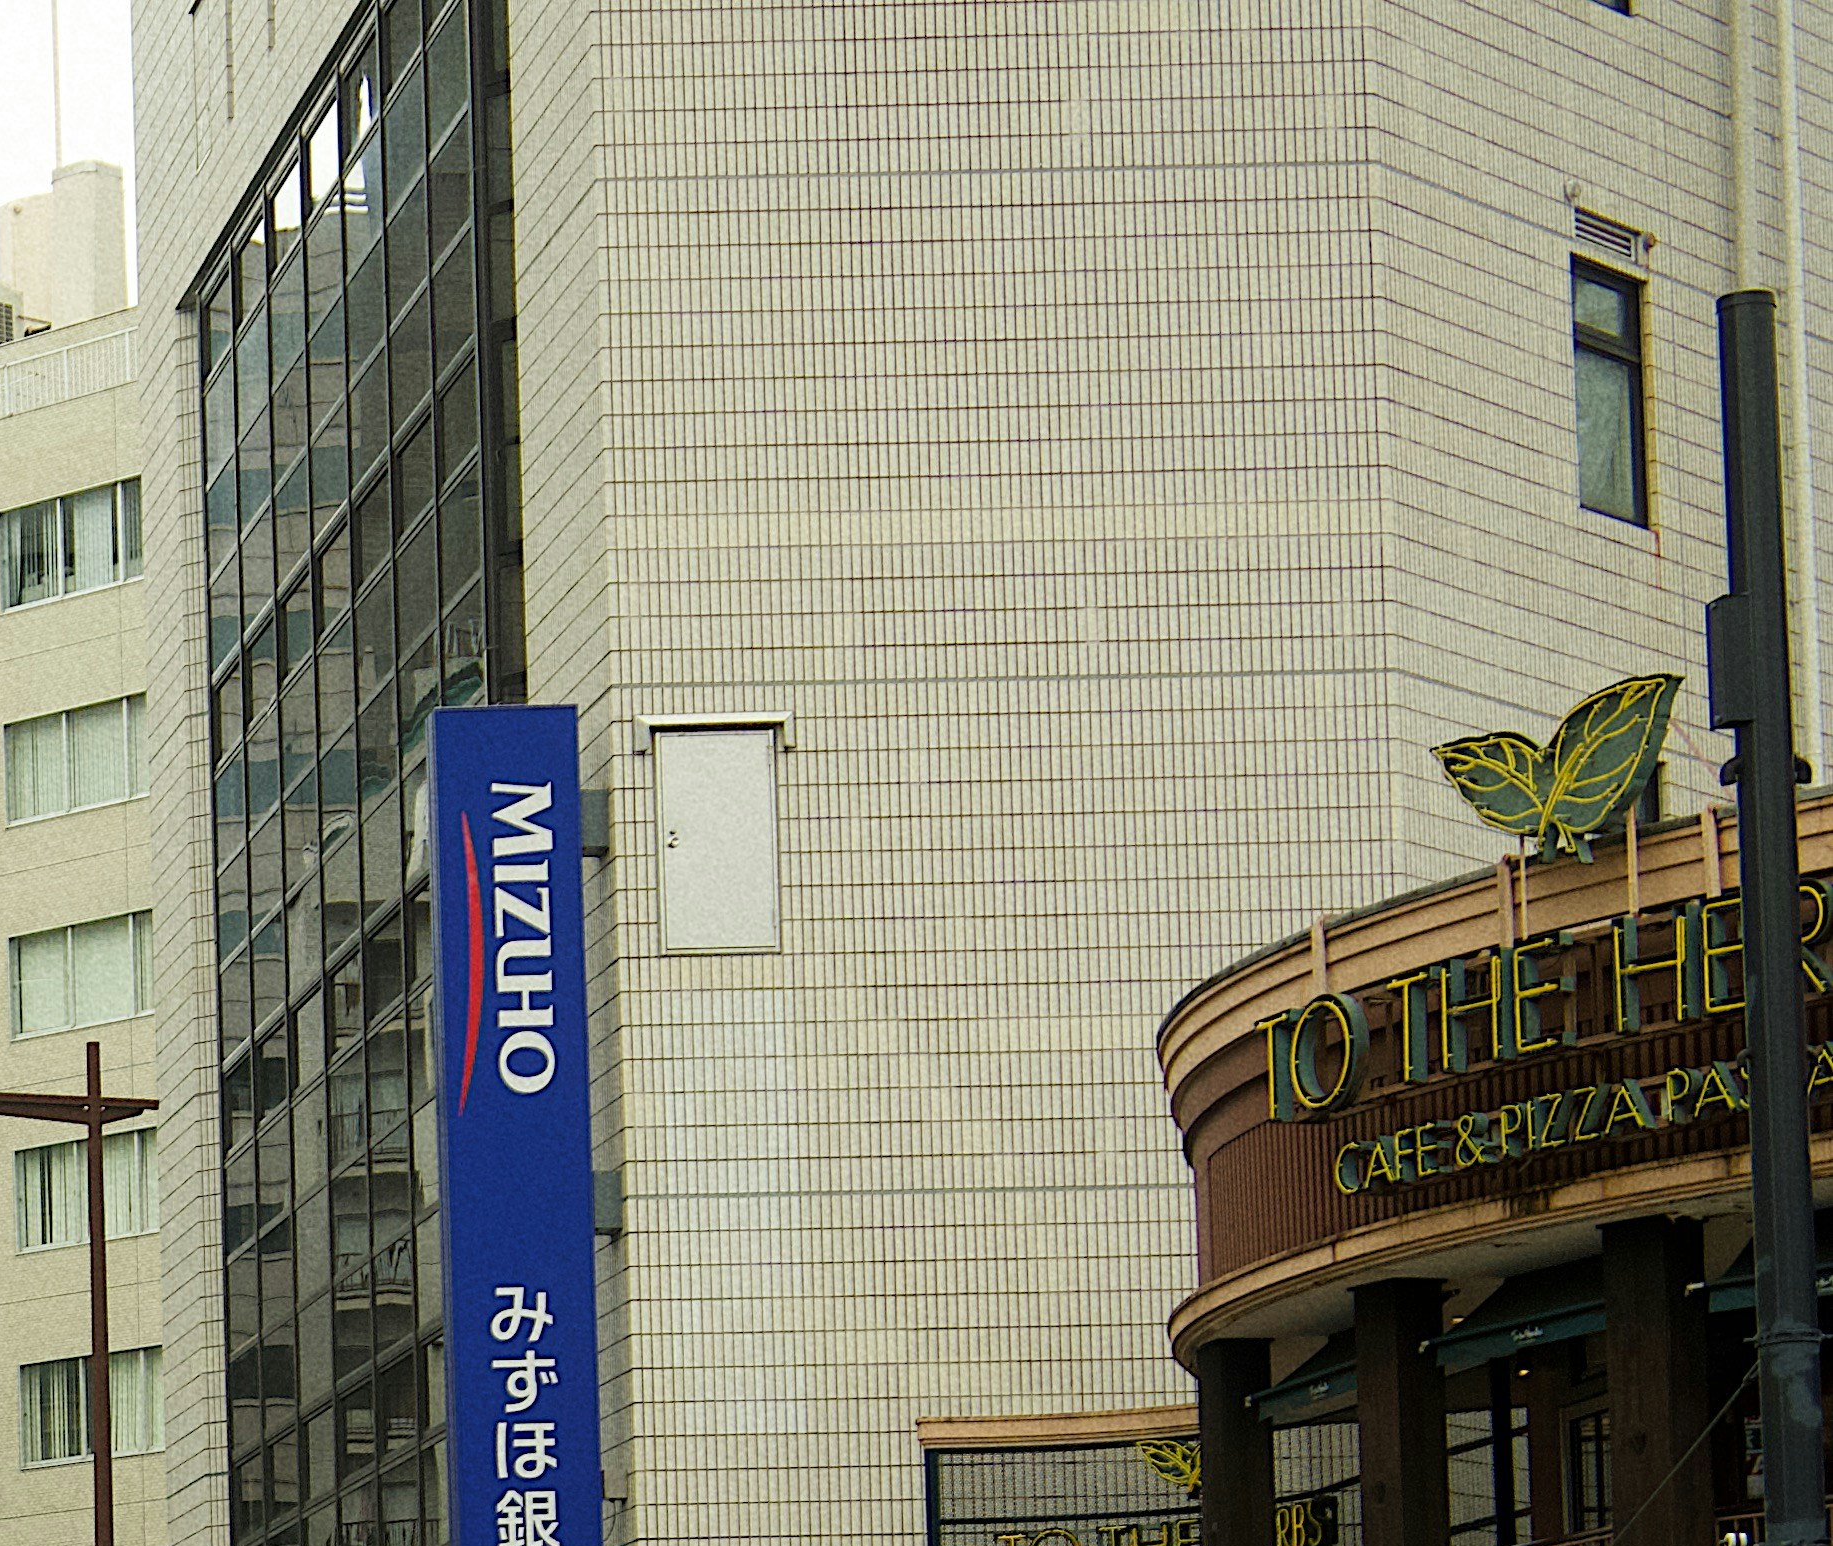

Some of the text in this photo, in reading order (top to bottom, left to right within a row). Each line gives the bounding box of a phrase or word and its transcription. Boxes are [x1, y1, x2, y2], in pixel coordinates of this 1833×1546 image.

[490, 778, 555, 1095] MIZUHO
[1256, 994, 1366, 1122] TO
[1387, 932, 1578, 1084] THE
[1334, 1120, 1452, 1195] CAFE
[1500, 1078, 1658, 1155] PIZZA
